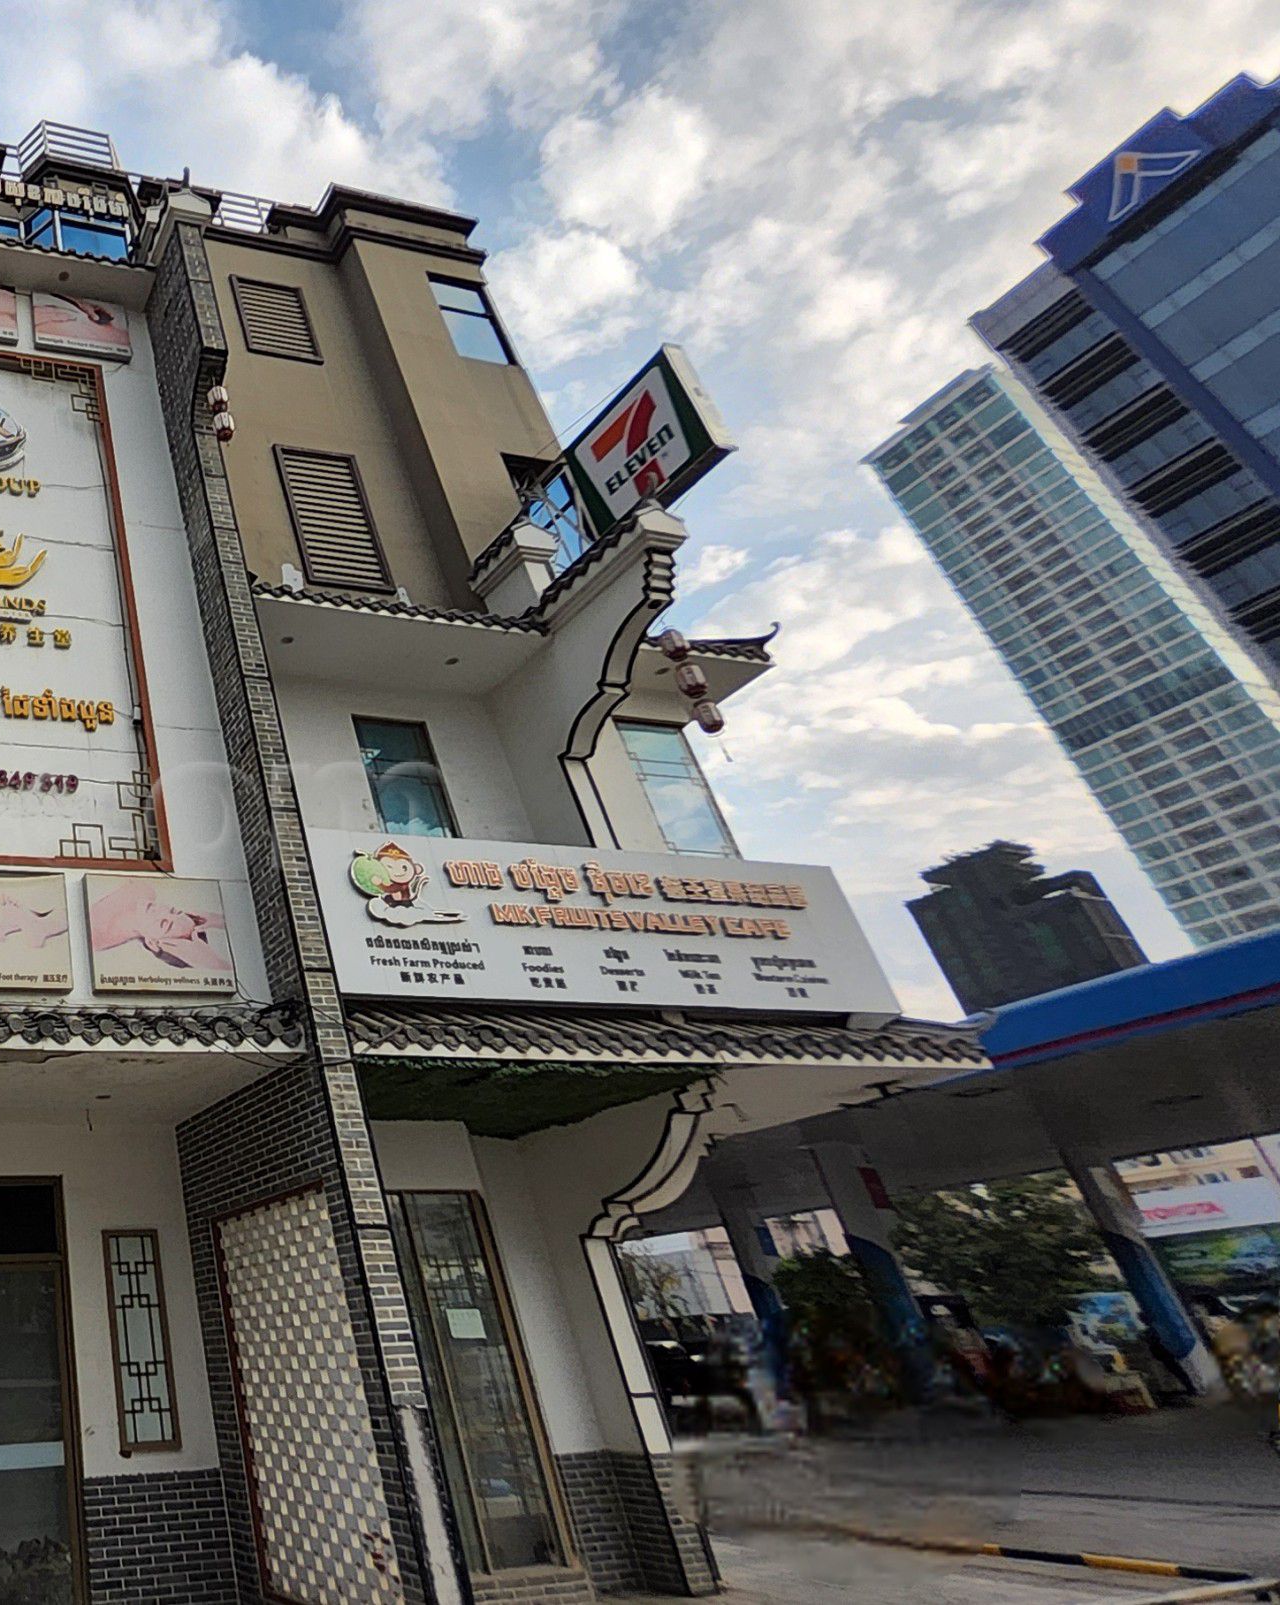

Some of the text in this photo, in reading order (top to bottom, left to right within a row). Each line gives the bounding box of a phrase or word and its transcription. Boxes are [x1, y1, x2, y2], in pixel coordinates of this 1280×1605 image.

[591, 389, 657, 463] 7
[489, 902, 536, 926] MK
[719, 916, 792, 939] CAFE
[370, 956, 485, 970] Fresh Farm Produced
